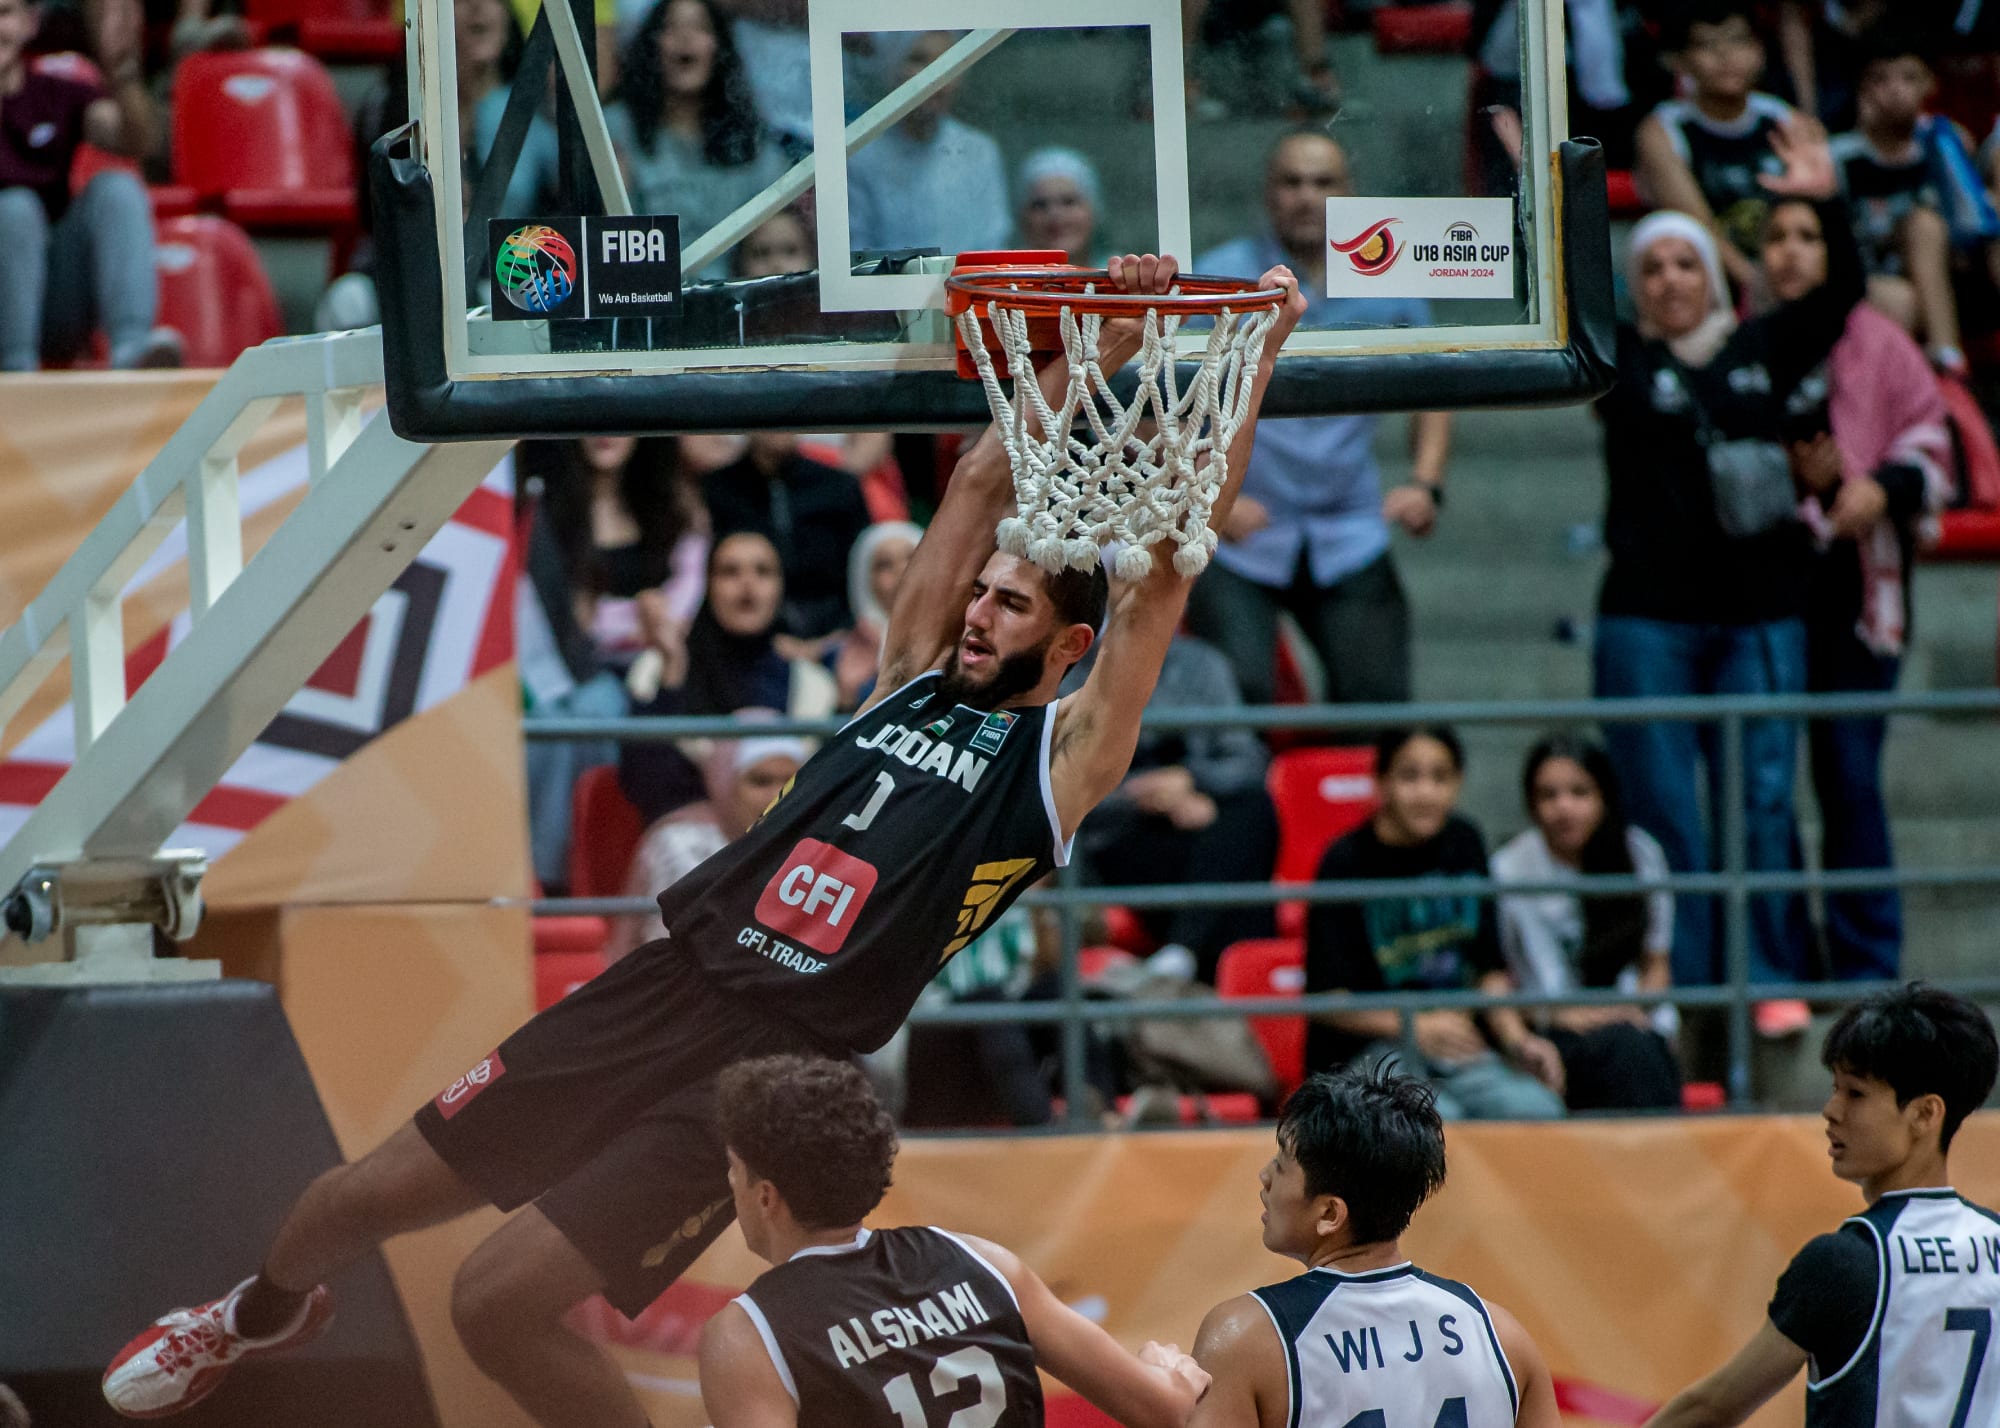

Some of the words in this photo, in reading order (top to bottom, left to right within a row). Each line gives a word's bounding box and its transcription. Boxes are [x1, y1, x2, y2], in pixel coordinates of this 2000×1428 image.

[602, 228, 666, 263] FIBA
[1413, 244, 1439, 262] U18
[1443, 244, 1477, 262] ASIA
[1480, 244, 1510, 262] CUP
[1450, 229, 1473, 242] FIBA
[1428, 268, 1469, 278] JORDAN
[1470, 268, 1495, 278] 2024
[598, 292, 614, 304] We
[615, 291, 630, 304] Are
[631, 291, 673, 303] Basketball
[981, 729, 1001, 741] FIBA
[778, 864, 856, 927] CFI
[736, 926, 828, 973] CFI.TRADE
[1898, 1235, 1959, 1274] LEE
[1966, 1235, 1979, 1274] J
[827, 1281, 990, 1369] ALSHAMI
[1323, 1326, 1385, 1373] WI
[1403, 1320, 1424, 1362] J
[1438, 1314, 1464, 1356] S
[1944, 1307, 1992, 1428] 7
